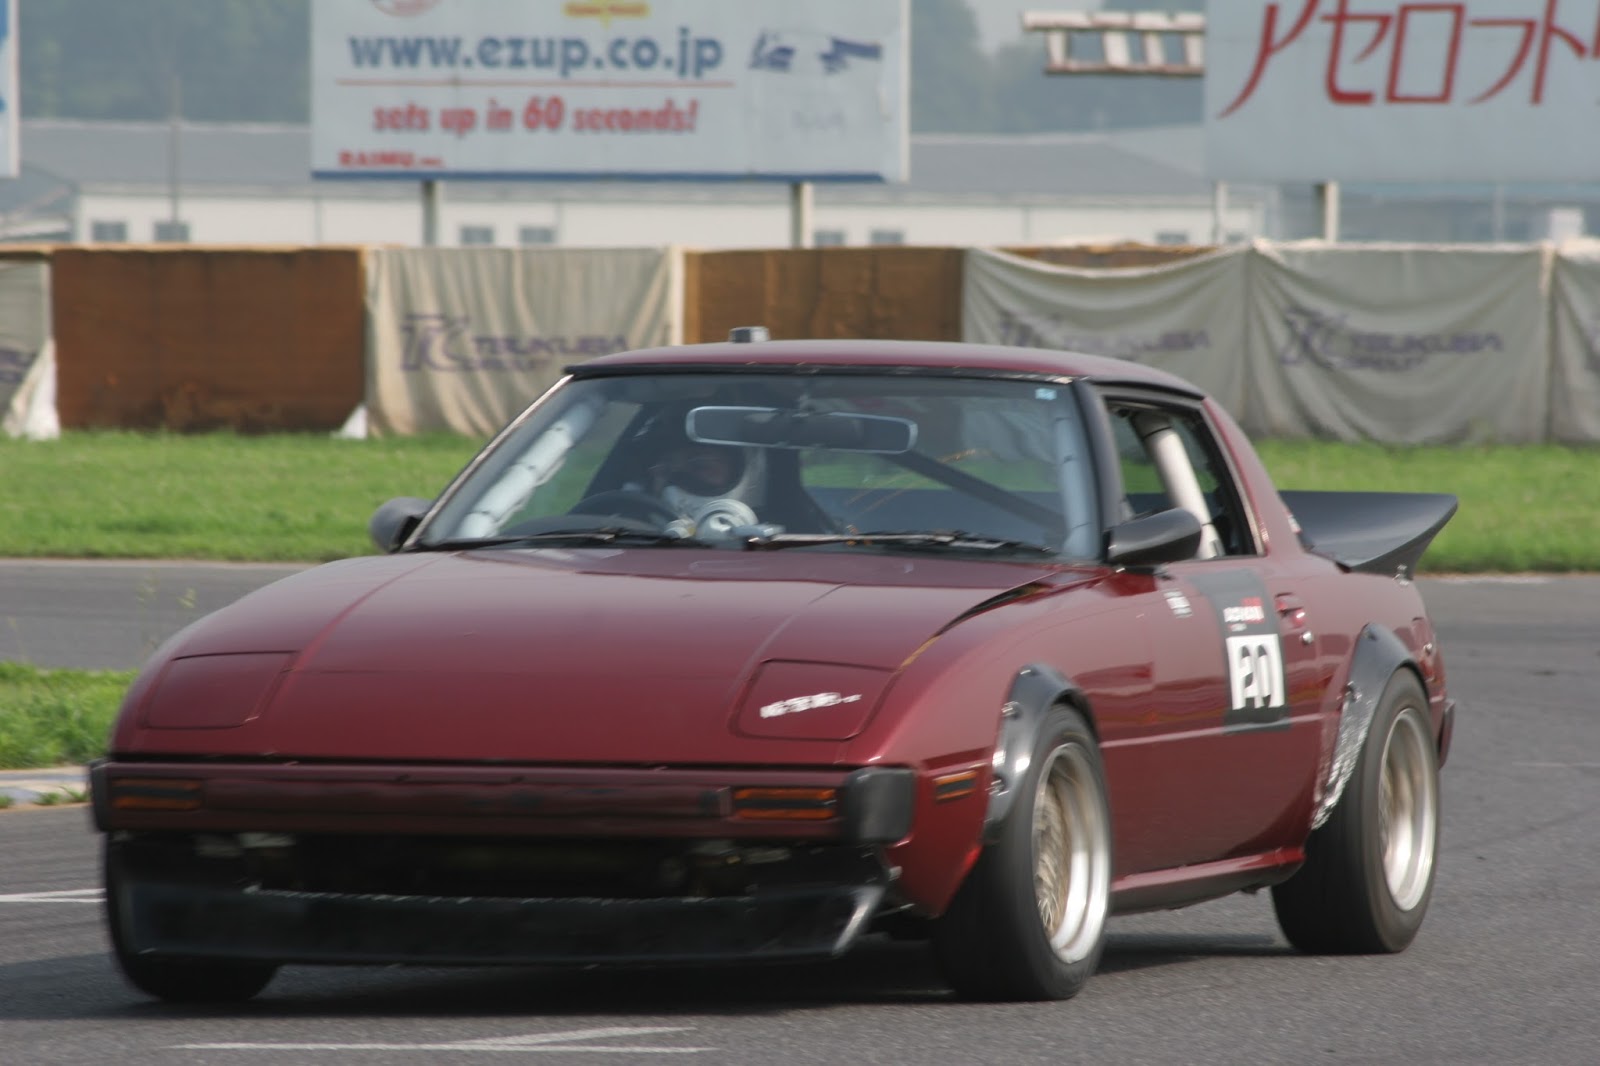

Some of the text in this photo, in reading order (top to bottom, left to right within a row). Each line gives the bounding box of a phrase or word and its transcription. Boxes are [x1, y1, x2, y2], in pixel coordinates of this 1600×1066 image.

[349, 27, 724, 78] www.ezup.co.jp
[373, 96, 698, 135] sets up in 60 seconds!
